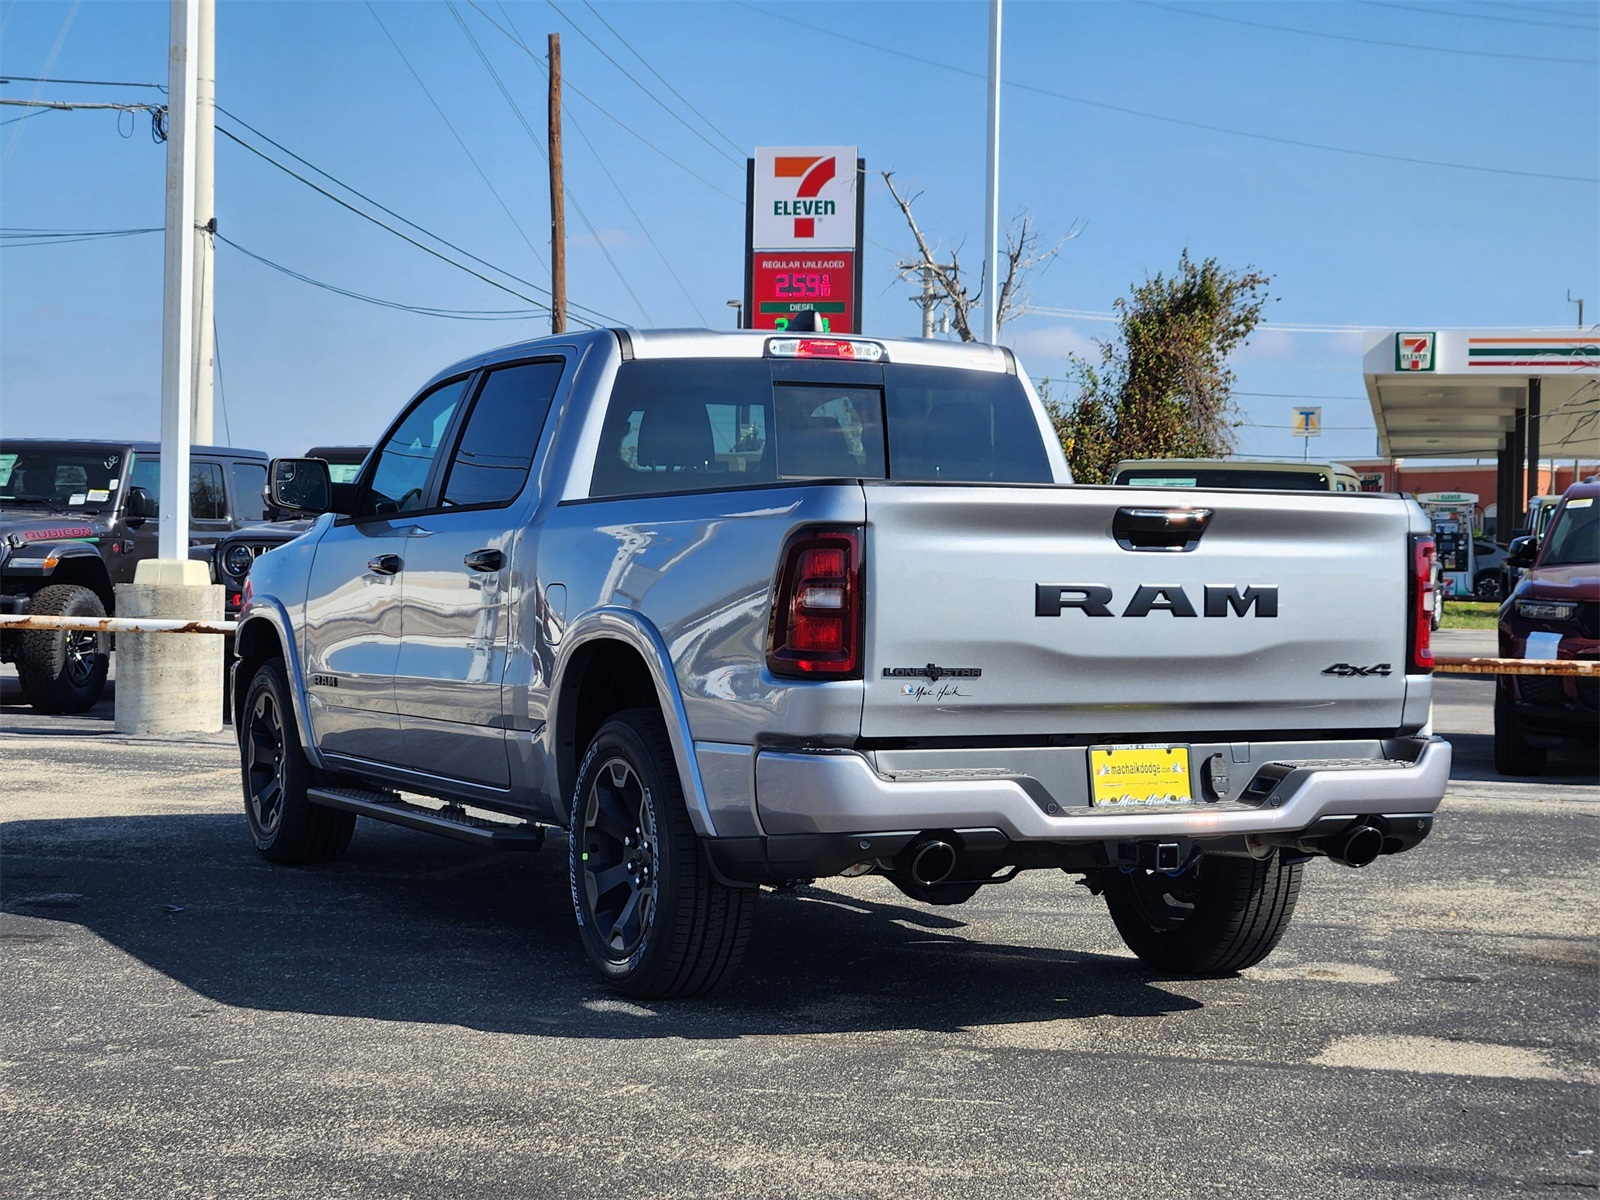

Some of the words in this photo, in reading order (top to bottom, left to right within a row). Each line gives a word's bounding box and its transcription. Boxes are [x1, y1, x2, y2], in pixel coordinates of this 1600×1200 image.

[762, 260, 801, 269] REGULAR
[802, 260, 845, 269] UNLEADED
[1299, 411, 1316, 430] T
[24, 526, 93, 541] RUBICON
[1035, 582, 1279, 618] RAM
[883, 667, 926, 677] LONE
[941, 667, 982, 677] STAR
[1321, 663, 1393, 676] 4x4
[313, 675, 339, 687] RAM
